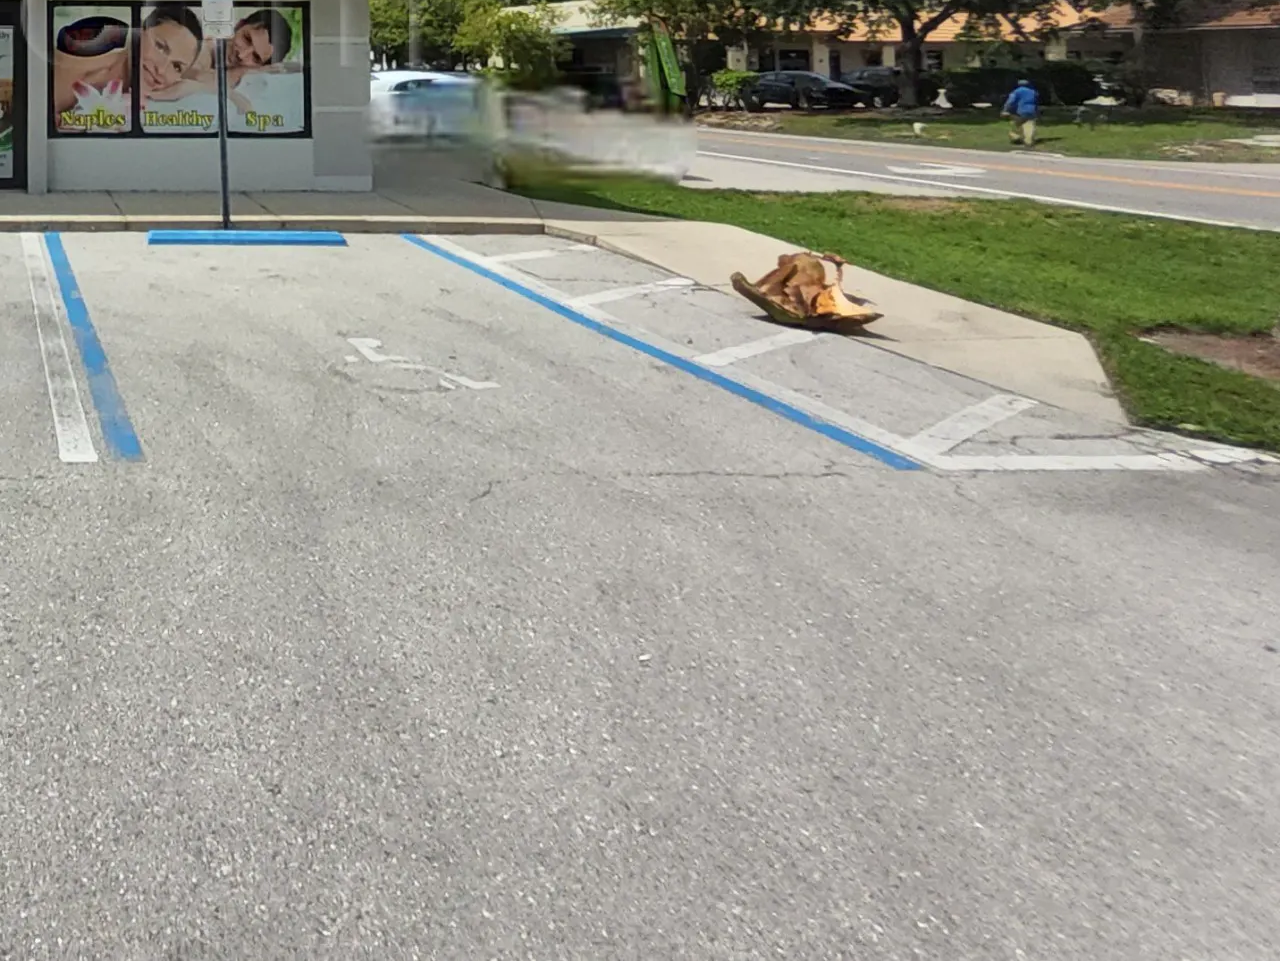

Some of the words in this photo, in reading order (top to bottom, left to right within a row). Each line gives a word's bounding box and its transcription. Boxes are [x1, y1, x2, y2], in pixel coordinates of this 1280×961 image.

[58, 109, 127, 129] Naples
[143, 109, 214, 129] Healthy
[244, 109, 285, 129] Spa
